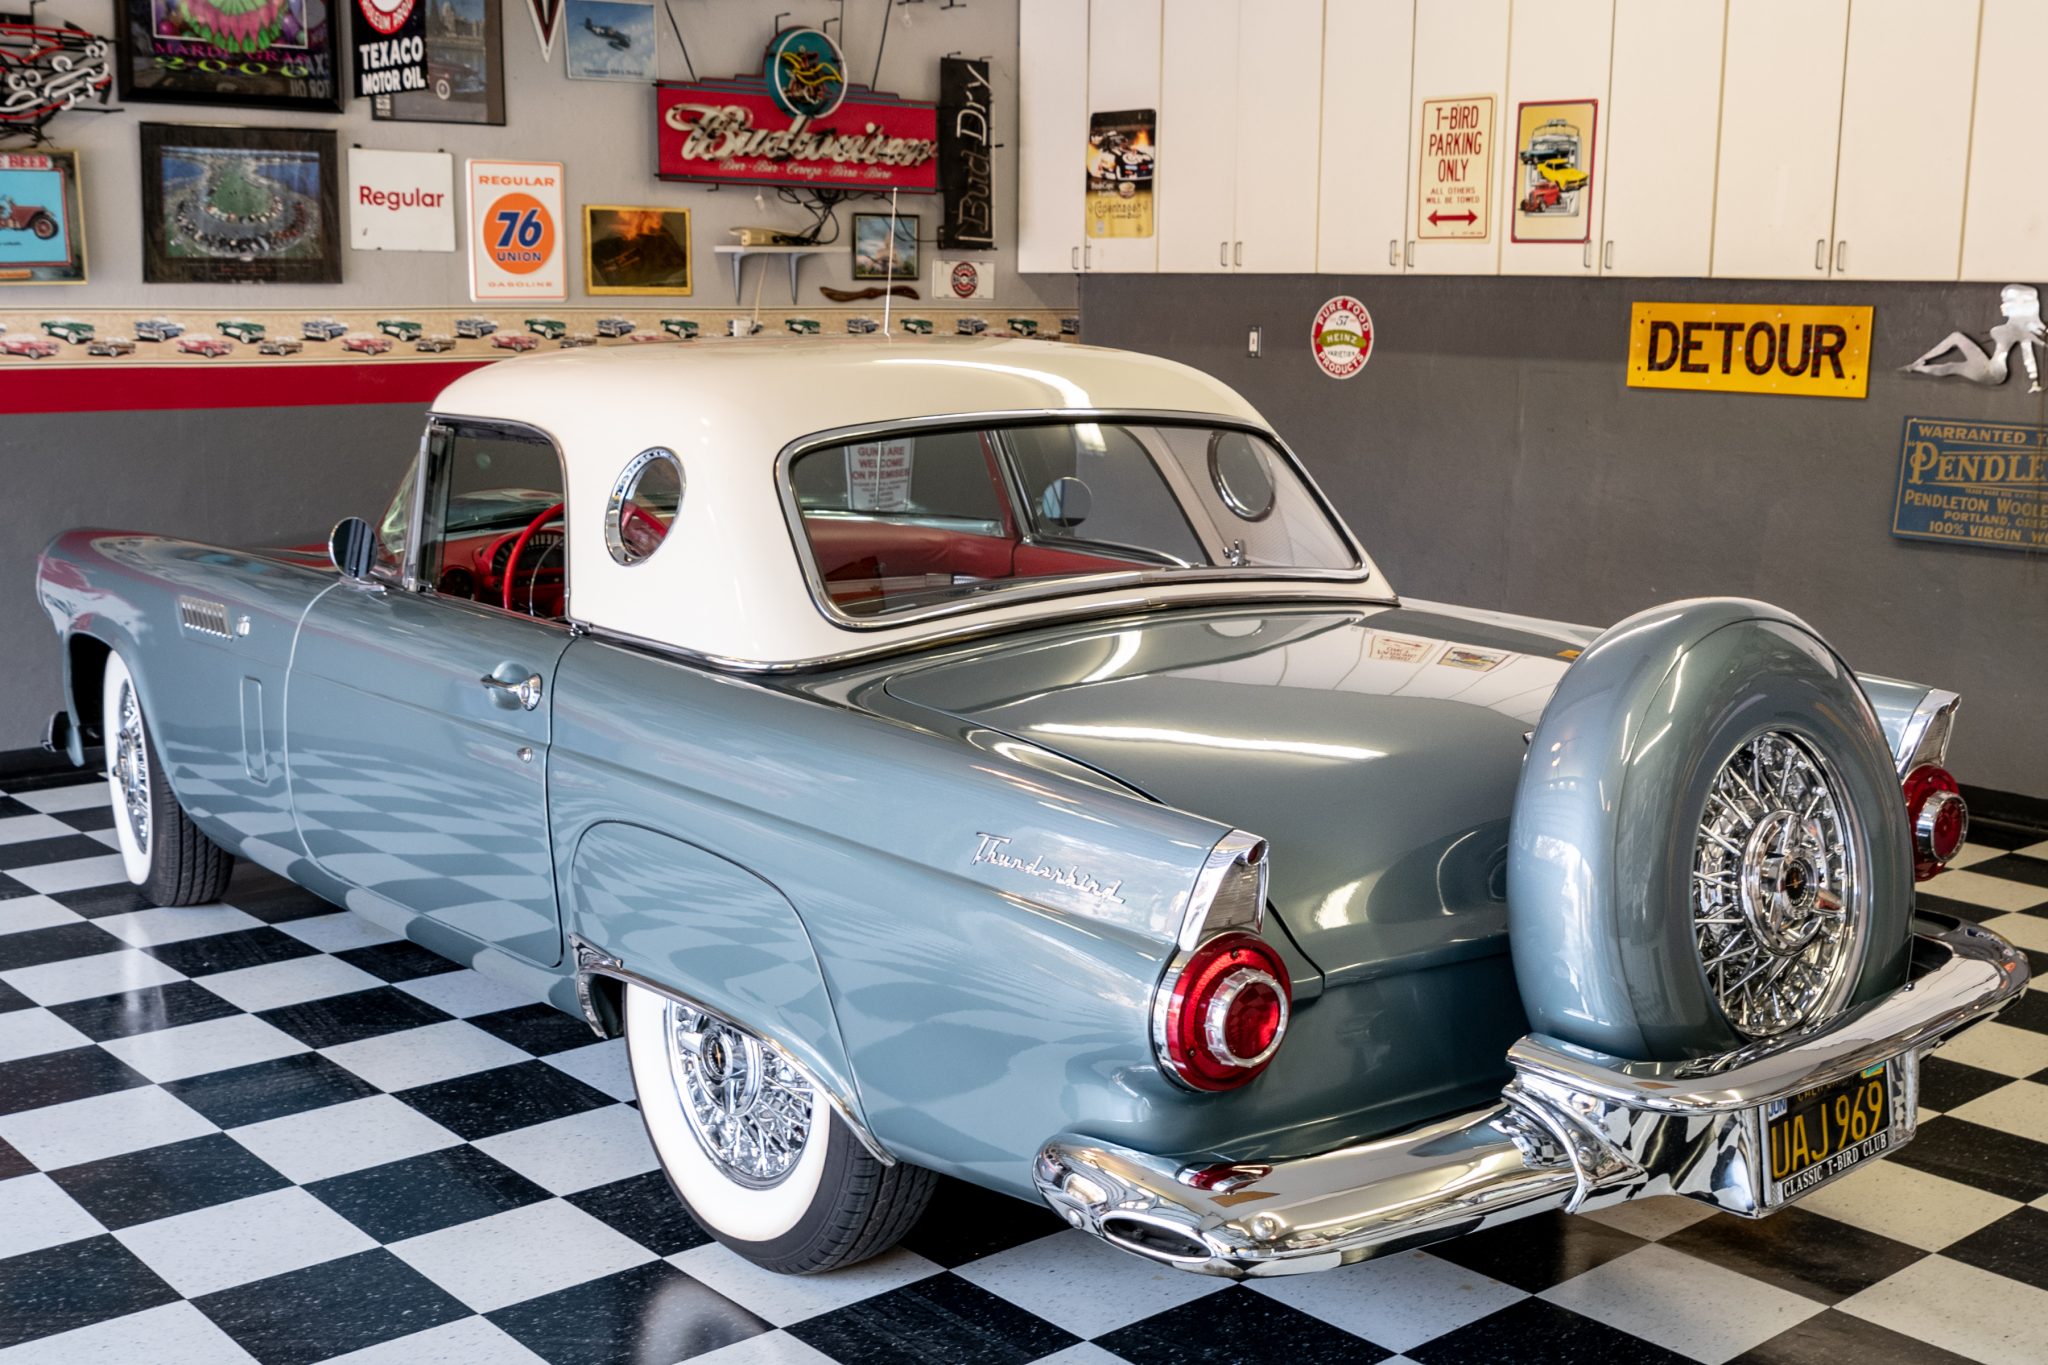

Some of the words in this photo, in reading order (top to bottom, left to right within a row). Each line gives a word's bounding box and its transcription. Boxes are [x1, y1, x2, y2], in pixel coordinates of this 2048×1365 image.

[155, 43, 230, 59] MARDI
[359, 35, 424, 70] TEXACO
[361, 68, 401, 95] MOTOR
[402, 65, 426, 90] OIL
[957, 63, 992, 146] Dry
[1436, 105, 1479, 130] T-BIRD
[665, 103, 939, 166] Budweiser
[1429, 131, 1482, 157] PARKING
[9, 153, 48, 168] BEER
[1438, 158, 1469, 182] ONLY
[478, 175, 555, 187] REGULAR
[957, 150, 990, 232] Bud
[1431, 187, 1443, 195] ALL
[1447, 186, 1476, 195] OTHERS
[359, 185, 444, 211] Regular
[1426, 196, 1442, 204] WILL
[1444, 196, 1453, 204] BE
[1457, 195, 1480, 204] TOWED
[496, 208, 543, 249] 76
[497, 252, 542, 262] UNION
[488, 280, 552, 288] GASOLINE
[1317, 300, 1344, 325] PURE
[1346, 301, 1370, 332] FOOD
[1335, 315, 1350, 326] 57
[1326, 333, 1358, 345] HEINZ
[1647, 320, 1847, 379] DETOUR
[1318, 351, 1364, 374] PRODUCTS
[1918, 425, 2027, 445] WARRANTED
[2037, 433, 2048, 445] T
[887, 446, 905, 456] ARE
[851, 471, 865, 480] ON
[1904, 489, 1989, 512] PENDLETON
[1944, 510, 2011, 527] PORTLAND,
[1929, 520, 1965, 535] 100%
[1969, 525, 2022, 541] VIRGIN
[971, 831, 1126, 904] Thunderbird
[1768, 1098, 1787, 1118] JUN
[1783, 1165, 1823, 1198] CLASSIC
[1826, 1147, 1860, 1176] T-BIRD
[1862, 1133, 1888, 1157] CLUB
